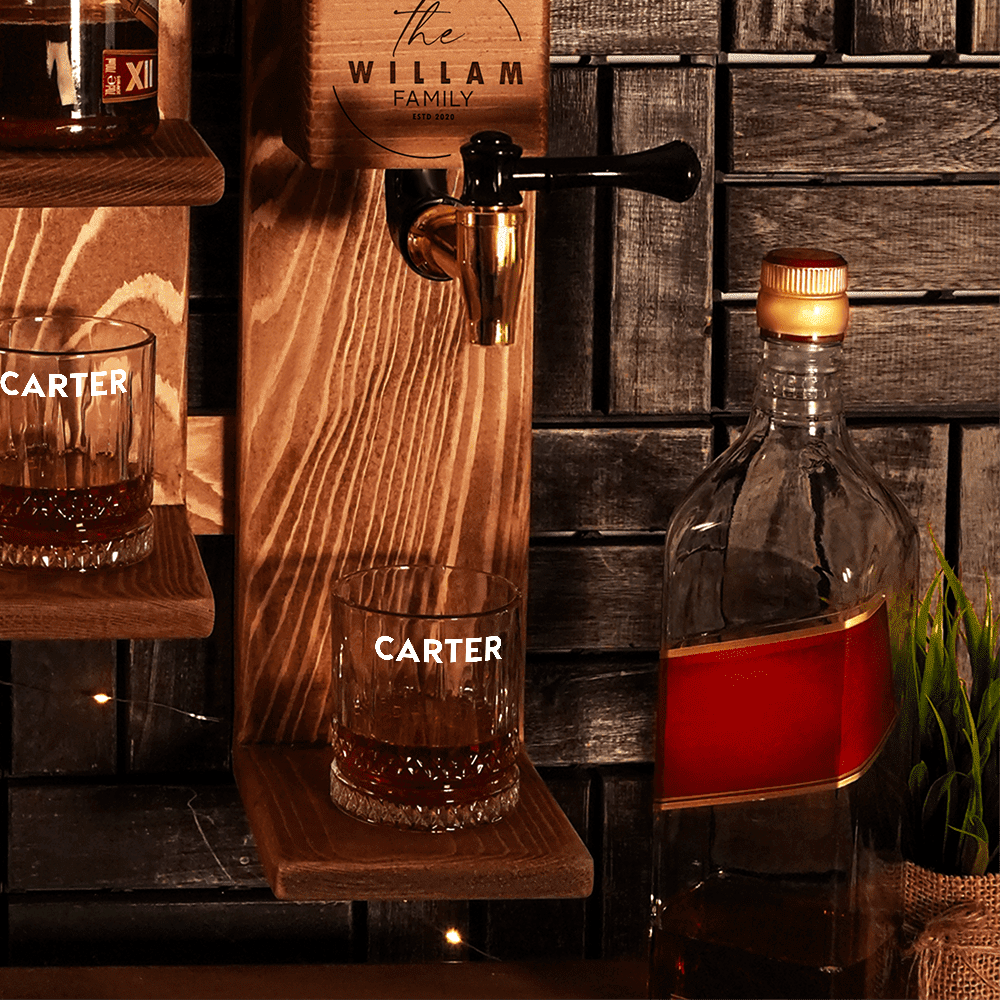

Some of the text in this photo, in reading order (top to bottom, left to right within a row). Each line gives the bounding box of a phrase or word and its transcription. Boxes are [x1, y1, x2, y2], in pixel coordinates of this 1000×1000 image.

[348, 61, 523, 85] WILLAM
[394, 90, 474, 107] FAMILY
[412, 113, 455, 121] ESTD 2020
[0, 369, 127, 398] CARTER
[374, 635, 502, 664] CARTER
